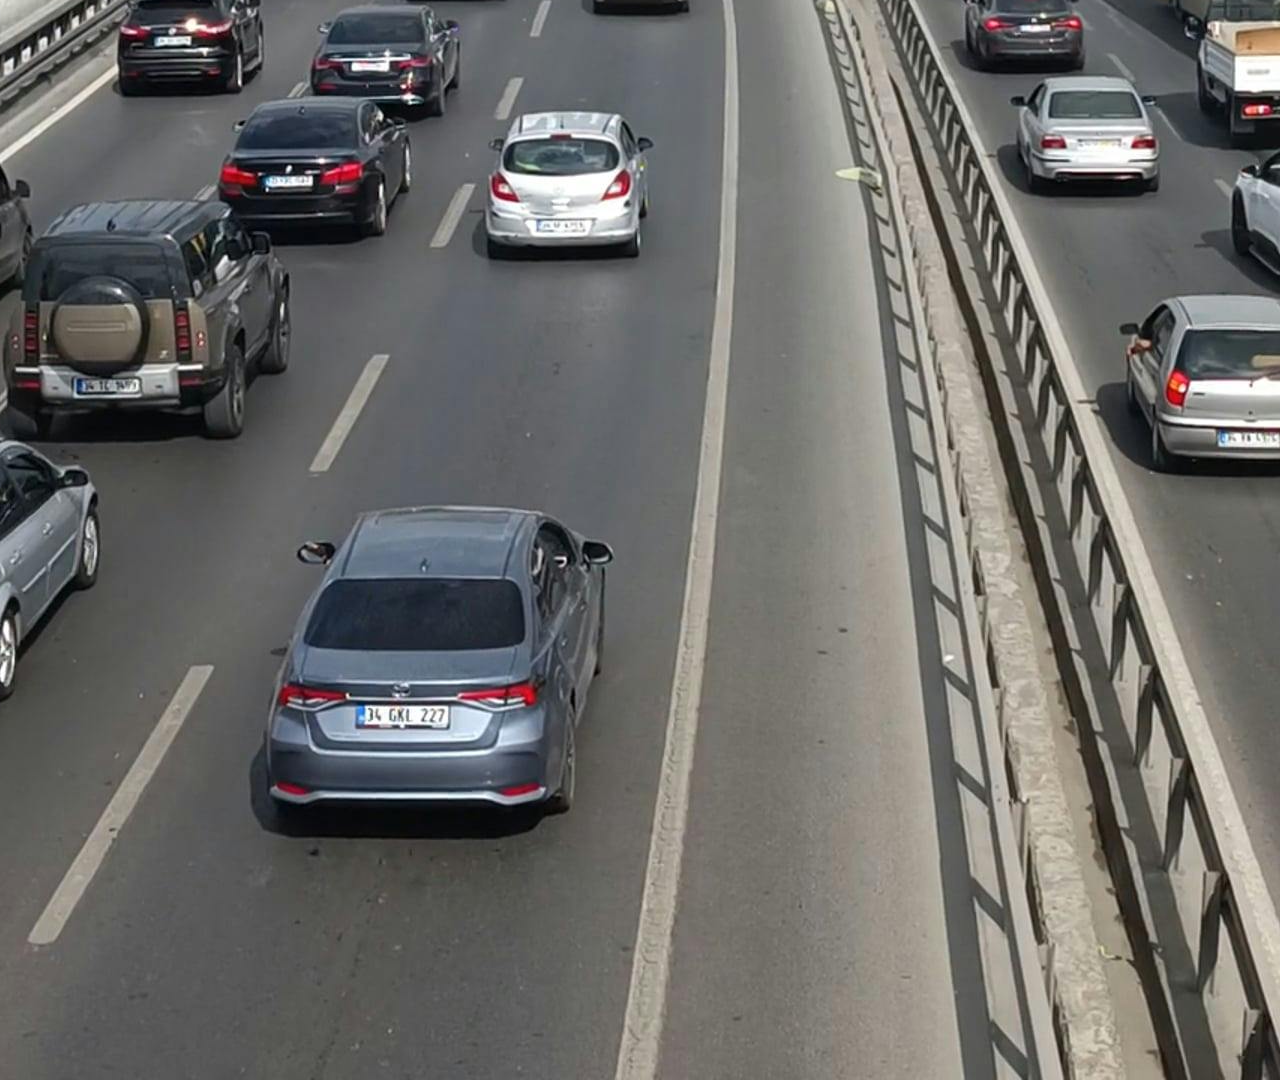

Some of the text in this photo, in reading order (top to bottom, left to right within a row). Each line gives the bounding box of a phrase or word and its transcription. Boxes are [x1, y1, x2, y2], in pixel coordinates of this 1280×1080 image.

[367, 707, 446, 723] 34 GKL 227
